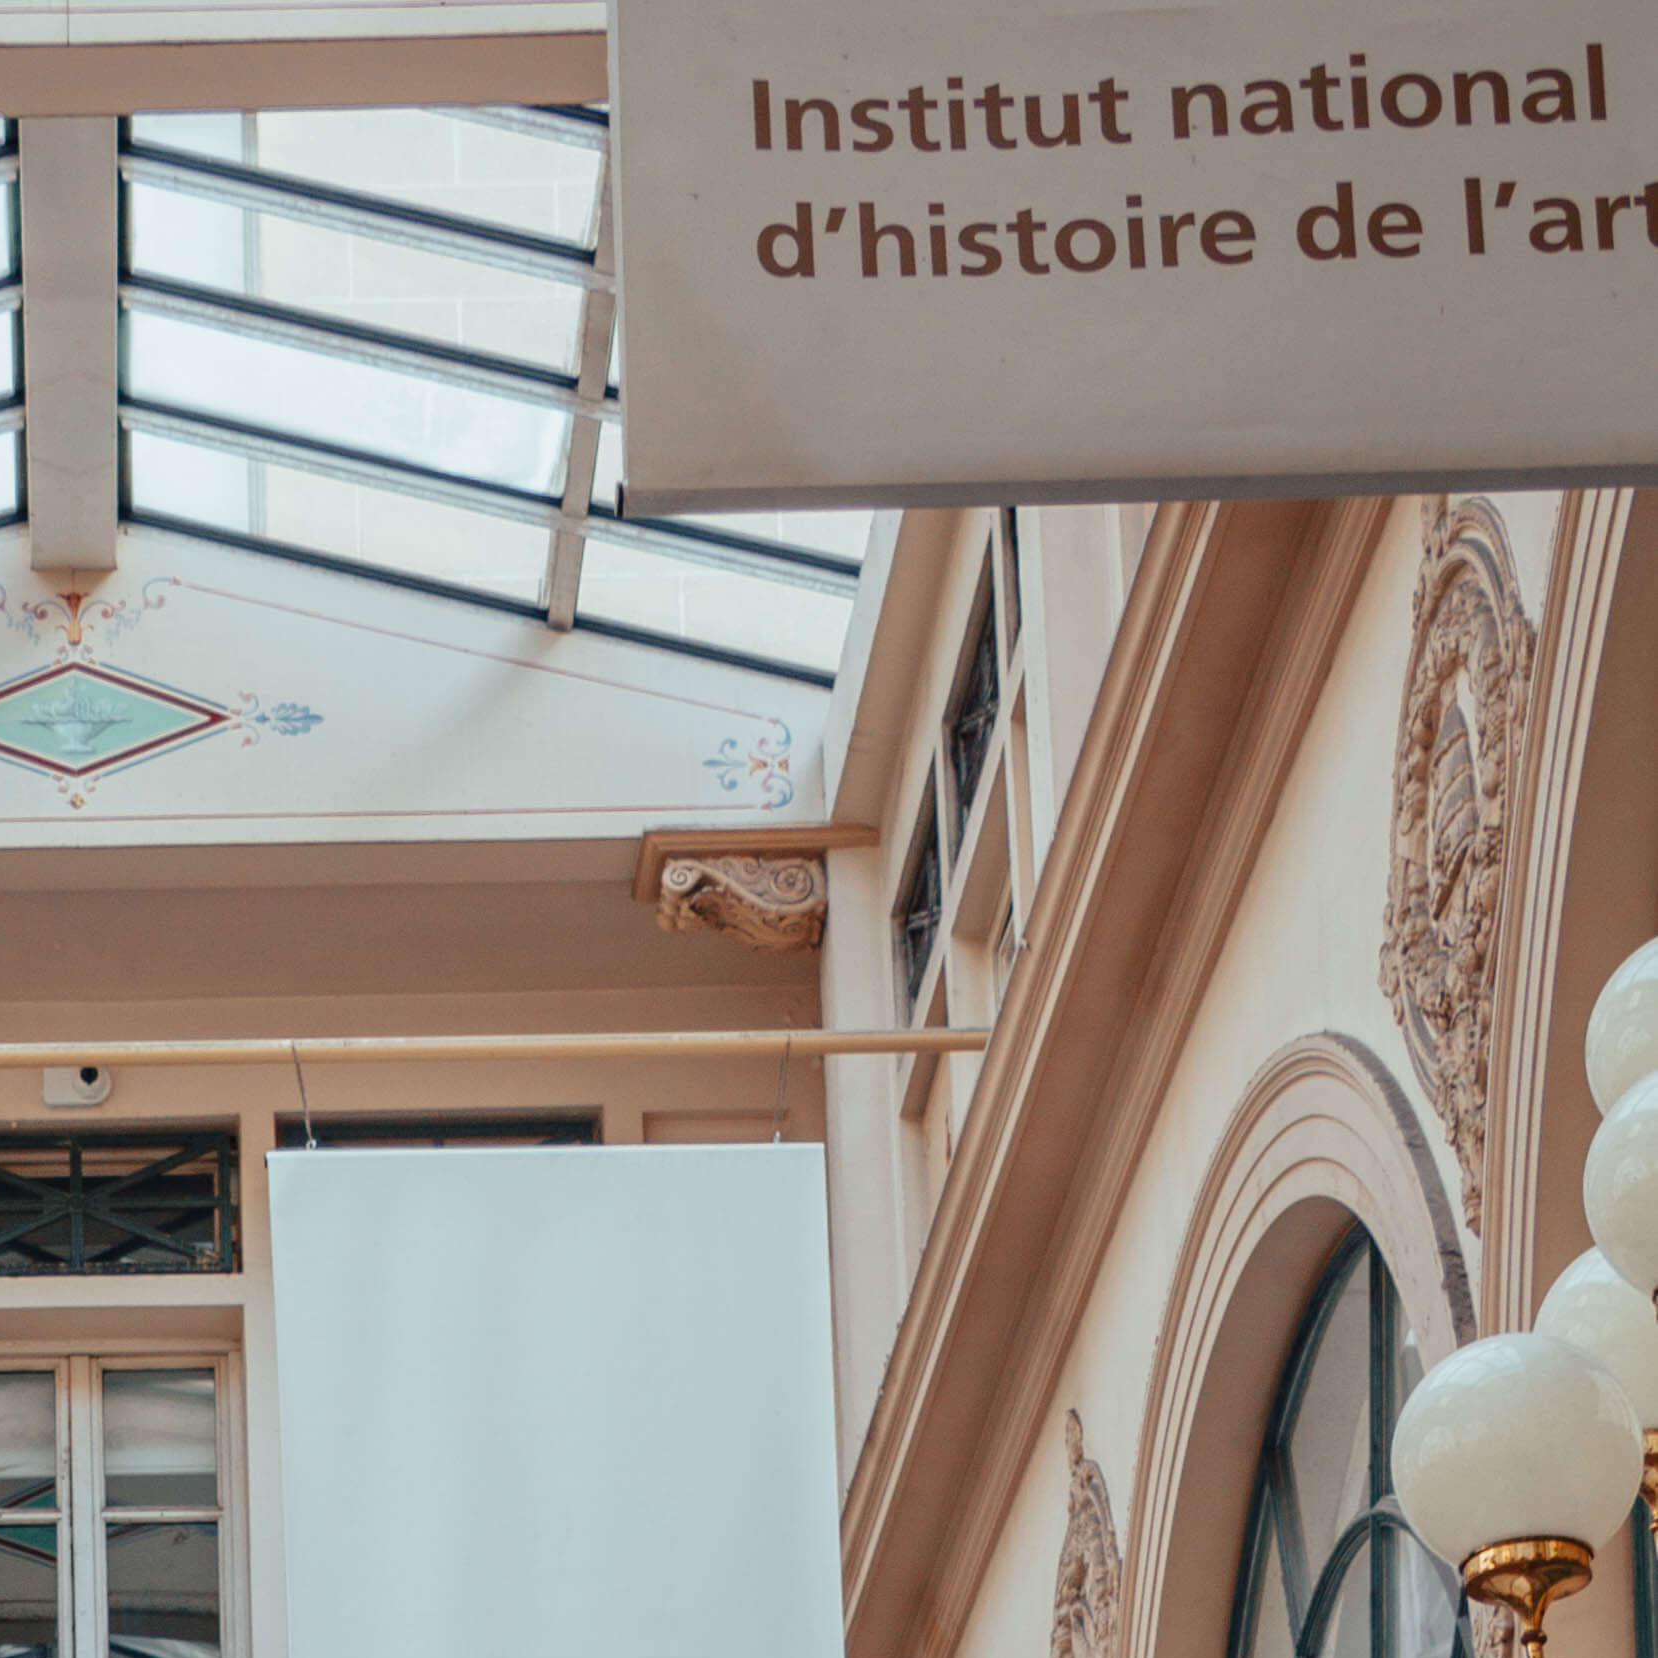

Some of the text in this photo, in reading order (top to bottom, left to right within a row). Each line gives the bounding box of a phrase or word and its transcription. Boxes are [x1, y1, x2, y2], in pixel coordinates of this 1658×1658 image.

[752, 42, 1607, 153] Institut national
[756, 177, 1658, 278] d’histoire de l’art
